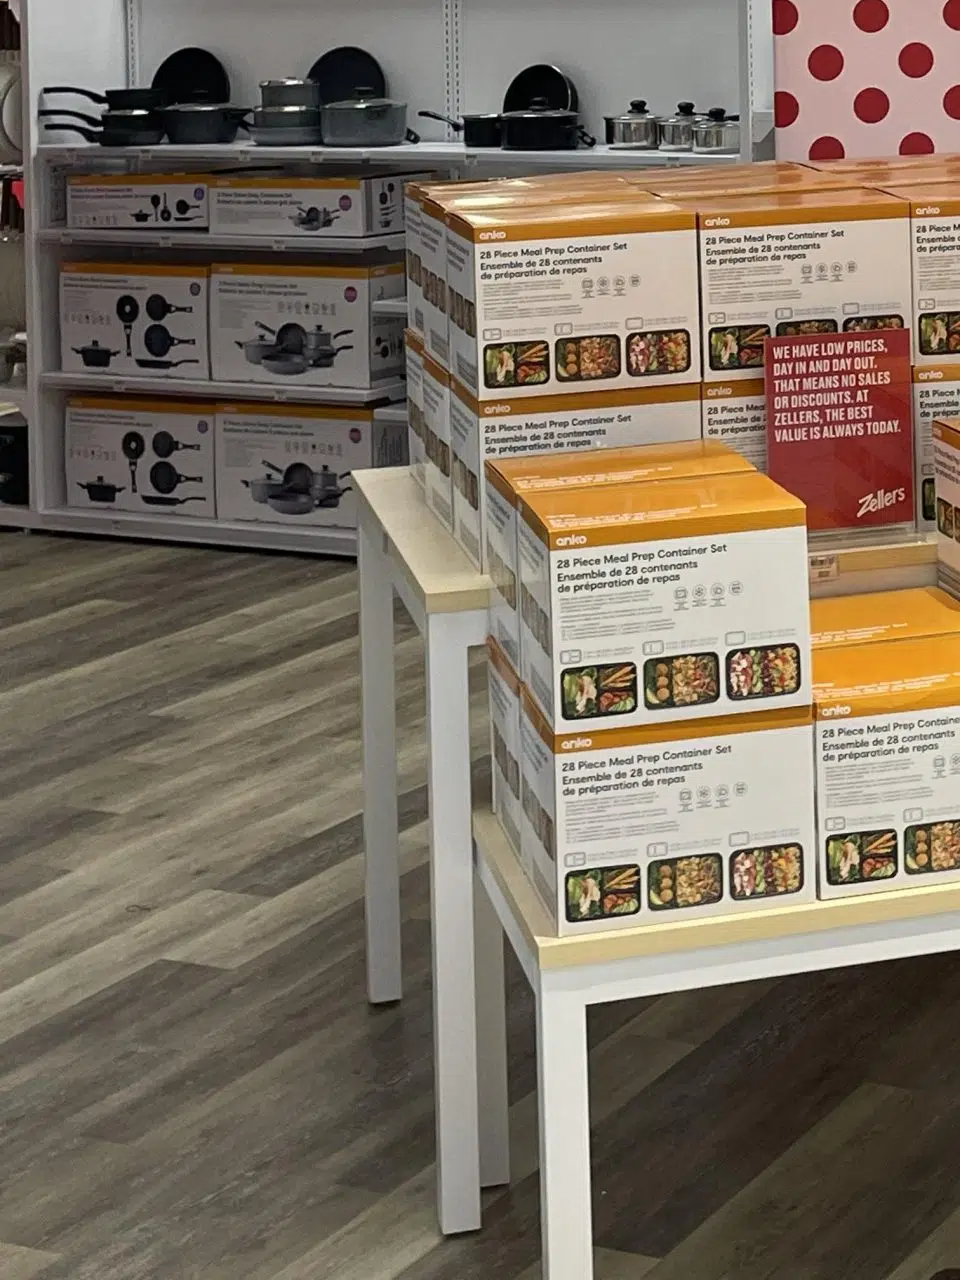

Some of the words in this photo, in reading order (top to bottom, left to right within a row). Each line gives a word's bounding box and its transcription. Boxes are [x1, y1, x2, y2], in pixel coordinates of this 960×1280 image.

[705, 217, 730, 226] anko
[479, 230, 506, 240] anko
[706, 237, 717, 245] 28
[718, 236, 742, 244] Piece
[744, 234, 764, 243] Meal
[766, 233, 786, 242] Prep
[787, 231, 829, 240] Container
[831, 229, 844, 237] Set
[480, 251, 492, 259] 28
[494, 250, 518, 258] Piece
[521, 248, 542, 256] Meal
[544, 247, 565, 256] Prep
[567, 244, 611, 254] Container
[613, 242, 627, 250] Set
[706, 247, 746, 256] Ensemble
[761, 245, 772, 253] 28
[774, 242, 821, 252] contenants
[480, 261, 523, 271] Ensemble
[525, 260, 537, 268] de
[539, 258, 551, 267] 28
[552, 256, 602, 266] contenants
[706, 257, 717, 265] de
[719, 255, 769, 266] préparation
[770, 253, 781, 261] de
[783, 253, 806, 261] repas
[480, 272, 492, 280] de
[494, 269, 547, 281] préparation
[549, 267, 560, 275] de
[562, 267, 587, 275] repas
[773, 346, 790, 359] WE
[792, 344, 819, 358] HAVE
[821, 341, 845, 355] LOW
[847, 339, 888, 354] PRICES,
[774, 363, 793, 376] DAY
[795, 362, 806, 374] IN
[809, 360, 830, 373] AND
[833, 358, 852, 371] DAY
[854, 356, 877, 369] OUT.
[774, 379, 800, 392] THAT
[802, 376, 839, 390] MEANS
[841, 374, 856, 387] NO
[858, 372, 891, 386] SALES
[775, 396, 789, 409] OR
[791, 391, 853, 407] DISCOUNTS.
[856, 390, 869, 402] AT
[775, 410, 823, 426] ZELLERS,
[826, 408, 845, 420] THE
[847, 406, 873, 418] BEST
[775, 428, 807, 442] VALUE
[810, 426, 820, 439] IS
[823, 423, 864, 439] ALWAYS
[866, 420, 901, 435] TODAY.
[857, 488, 905, 517] Zellers
[556, 534, 586, 546] anko
[557, 559, 570, 569] 28
[573, 557, 601, 567] Piece
[603, 553, 629, 564] Meal
[631, 552, 655, 562] Prep
[657, 547, 708, 559] Container
[710, 544, 727, 553] Set
[557, 569, 606, 582] Ensemble
[609, 568, 622, 577] de
[625, 565, 638, 576] 28
[640, 561, 698, 574] contenants
[557, 584, 571, 593] de
[573, 579, 634, 594] préparation
[636, 576, 649, 585] de
[652, 574, 680, 584] repas
[822, 705, 851, 716] anko
[822, 729, 835, 739] 28
[837, 728, 864, 737] Piece
[867, 723, 890, 734] Meal
[893, 722, 915, 731] Prep
[561, 737, 592, 749] anko
[822, 739, 869, 751] Ensemble
[872, 738, 884, 746] de
[887, 735, 899, 745] 28
[901, 730, 955, 743] contenants
[562, 762, 575, 772] 28
[578, 760, 606, 770] Piece
[609, 755, 634, 767] Meal
[637, 754, 660, 764] Prep
[662, 748, 712, 760] Container
[715, 745, 732, 754] Set
[822, 753, 835, 762] de
[837, 748, 895, 762] préparation
[897, 745, 910, 754] de
[912, 743, 939, 753] repas
[562, 772, 612, 785] Ensemble
[614, 770, 627, 779] de
[630, 768, 643, 778] 28
[645, 763, 703, 776] contenants
[562, 787, 576, 796] de
[578, 781, 639, 796] préparation
[642, 778, 654, 787] de
[657, 776, 685, 786] repas
